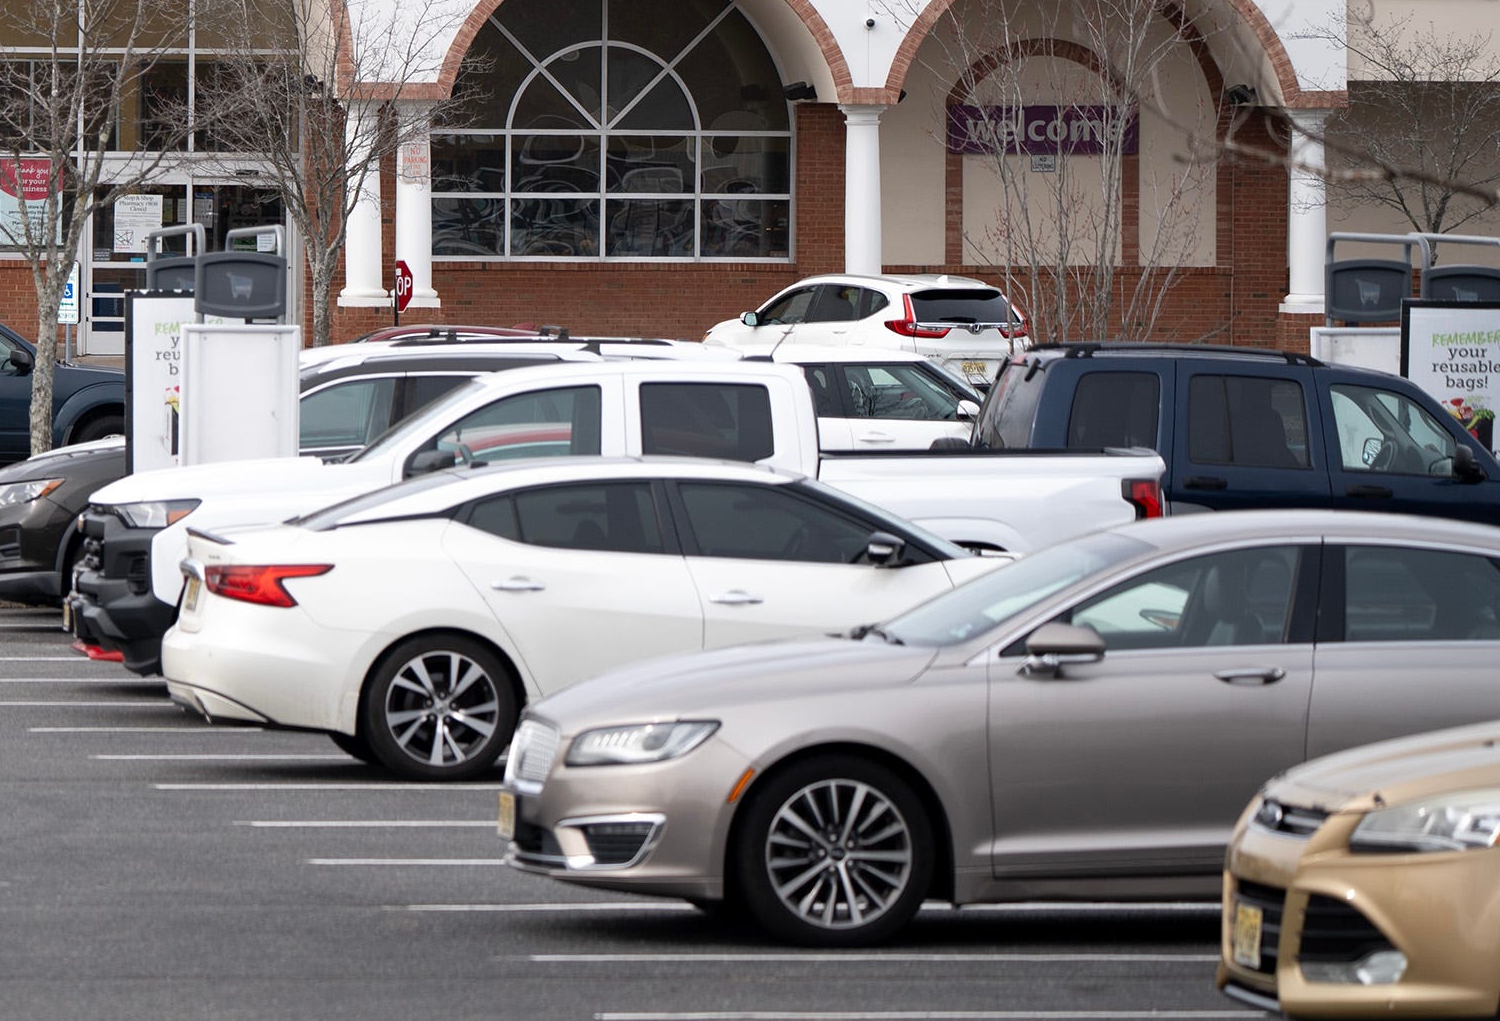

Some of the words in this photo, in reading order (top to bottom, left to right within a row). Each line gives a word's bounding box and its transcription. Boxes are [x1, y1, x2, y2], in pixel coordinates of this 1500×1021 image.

[396, 277, 412, 296] OP
[1448, 347, 1487, 361] your
[1432, 360, 1500, 373] reusable
[1446, 375, 1488, 392] bags!
